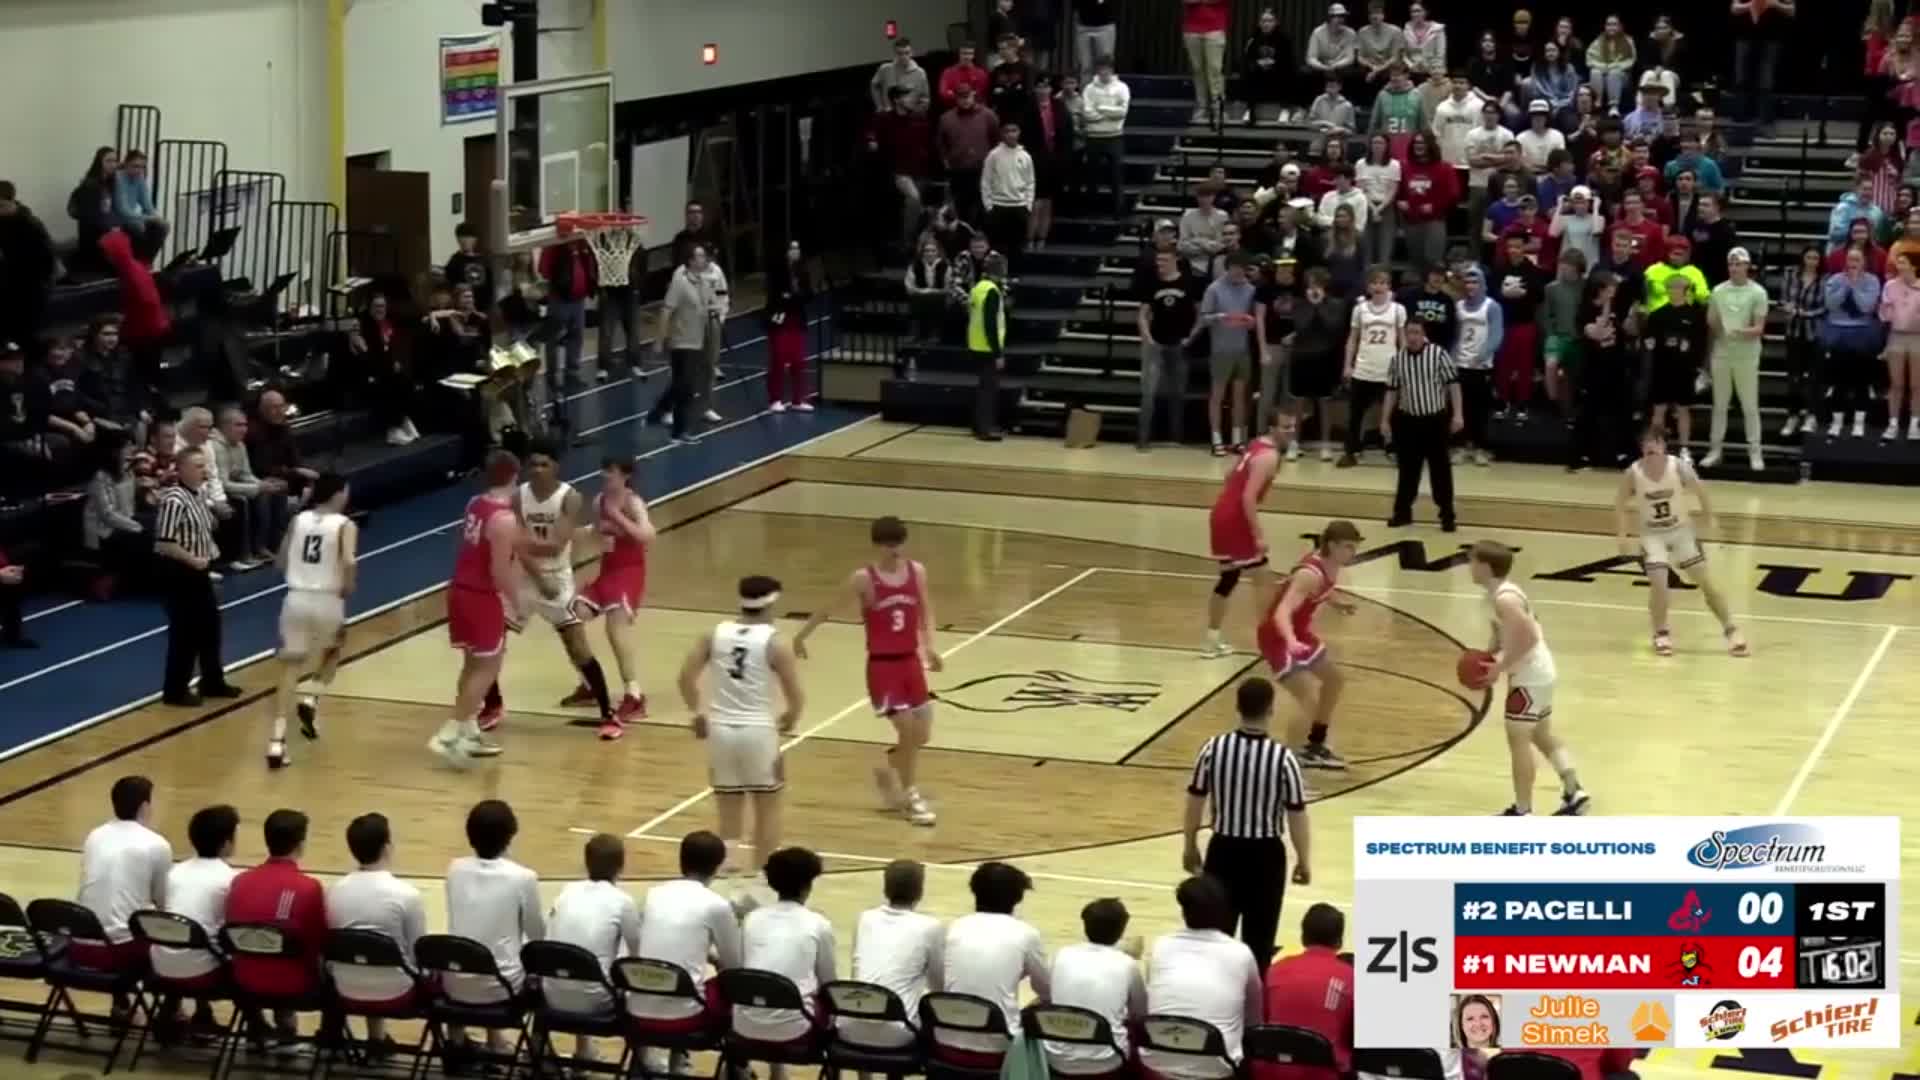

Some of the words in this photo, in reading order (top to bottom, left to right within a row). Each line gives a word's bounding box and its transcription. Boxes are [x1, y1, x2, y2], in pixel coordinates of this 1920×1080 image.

[1368, 329, 1388, 345] 22
[1464, 327, 1475, 342] 2
[302, 534, 323, 564] 13
[890, 609, 905, 632] 3
[727, 646, 749, 680] 3
